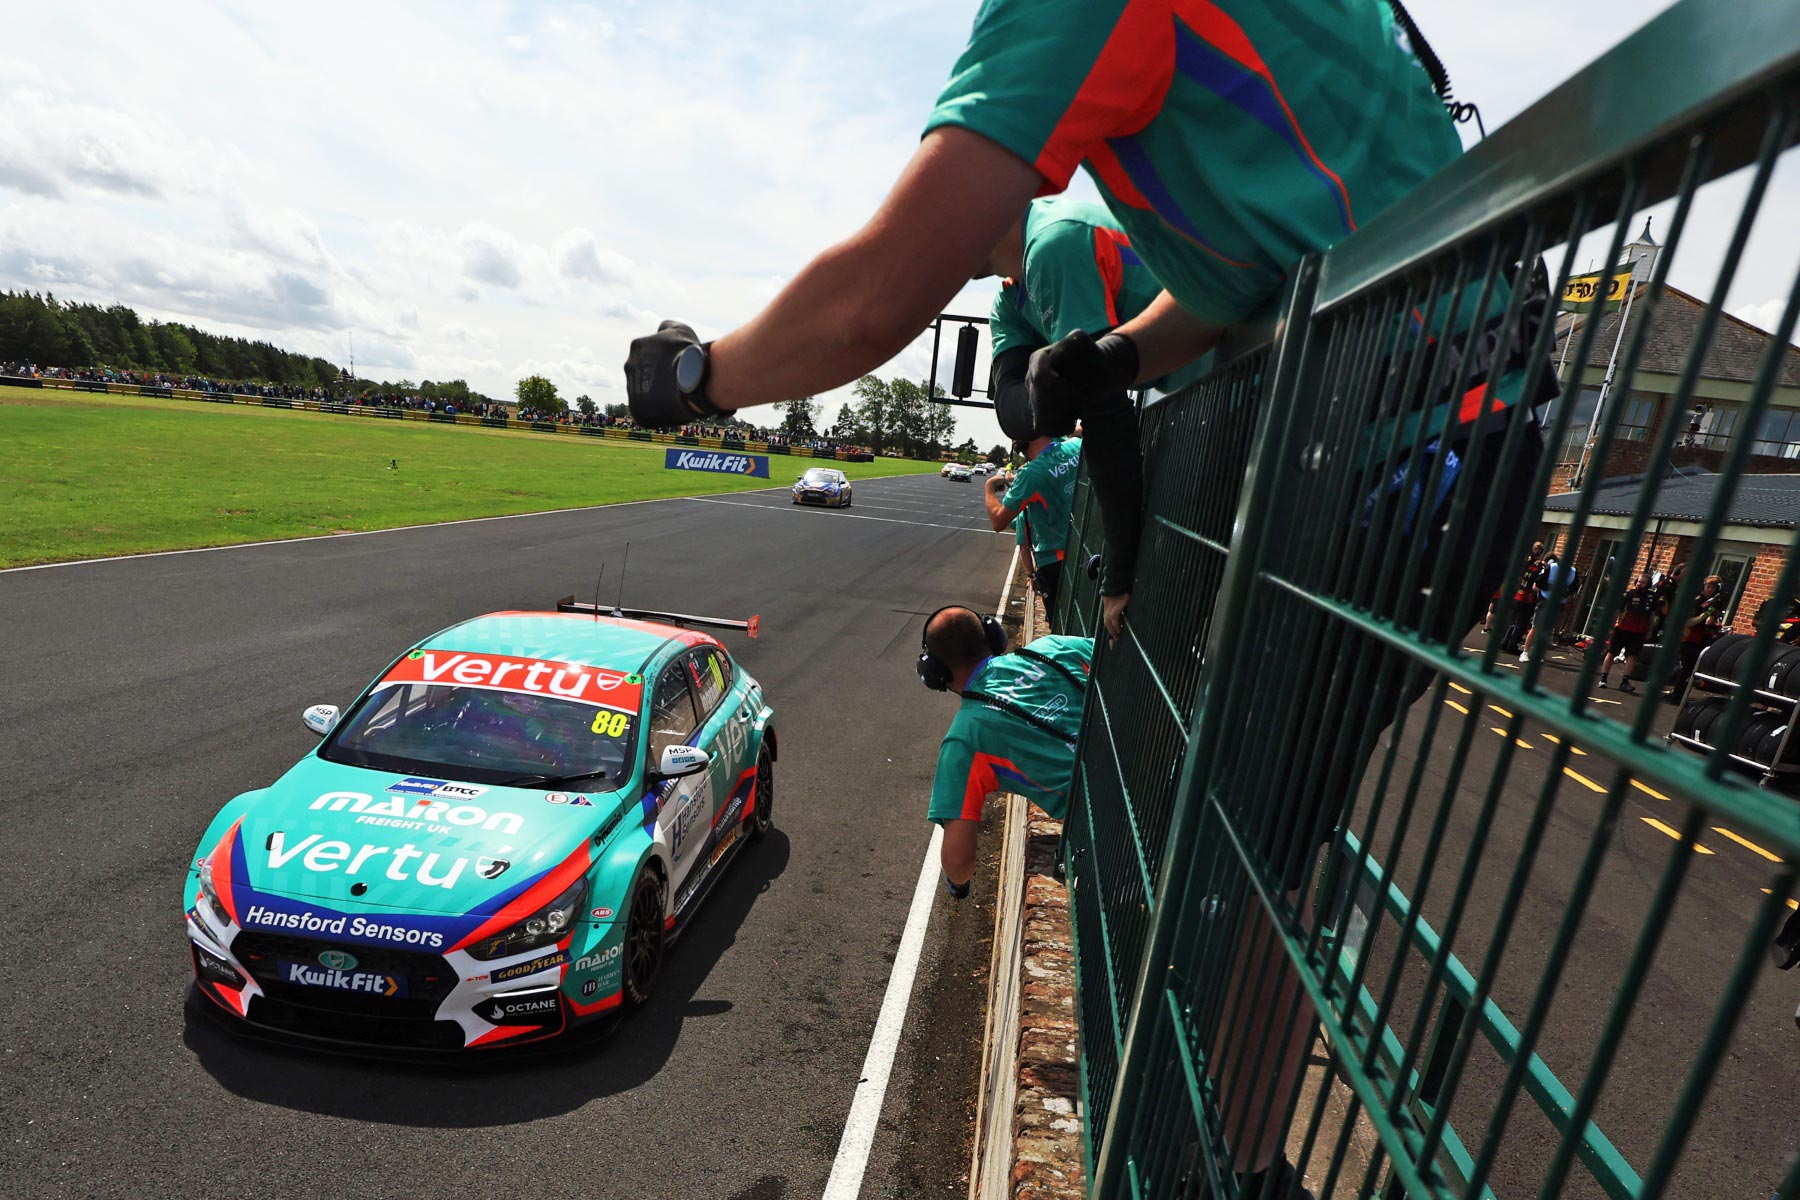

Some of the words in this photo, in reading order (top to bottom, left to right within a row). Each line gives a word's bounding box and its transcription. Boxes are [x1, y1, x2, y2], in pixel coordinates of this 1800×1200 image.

[422, 653, 592, 697] Vertu
[591, 710, 628, 737] 80
[442, 785, 480, 796] BTCC
[355, 815, 426, 831] FREIGHT
[427, 823, 453, 835] UK
[267, 832, 469, 889] Vertu
[246, 905, 347, 935] Hansford
[350, 916, 444, 948] Sensors
[506, 999, 556, 1013] OCTANE
